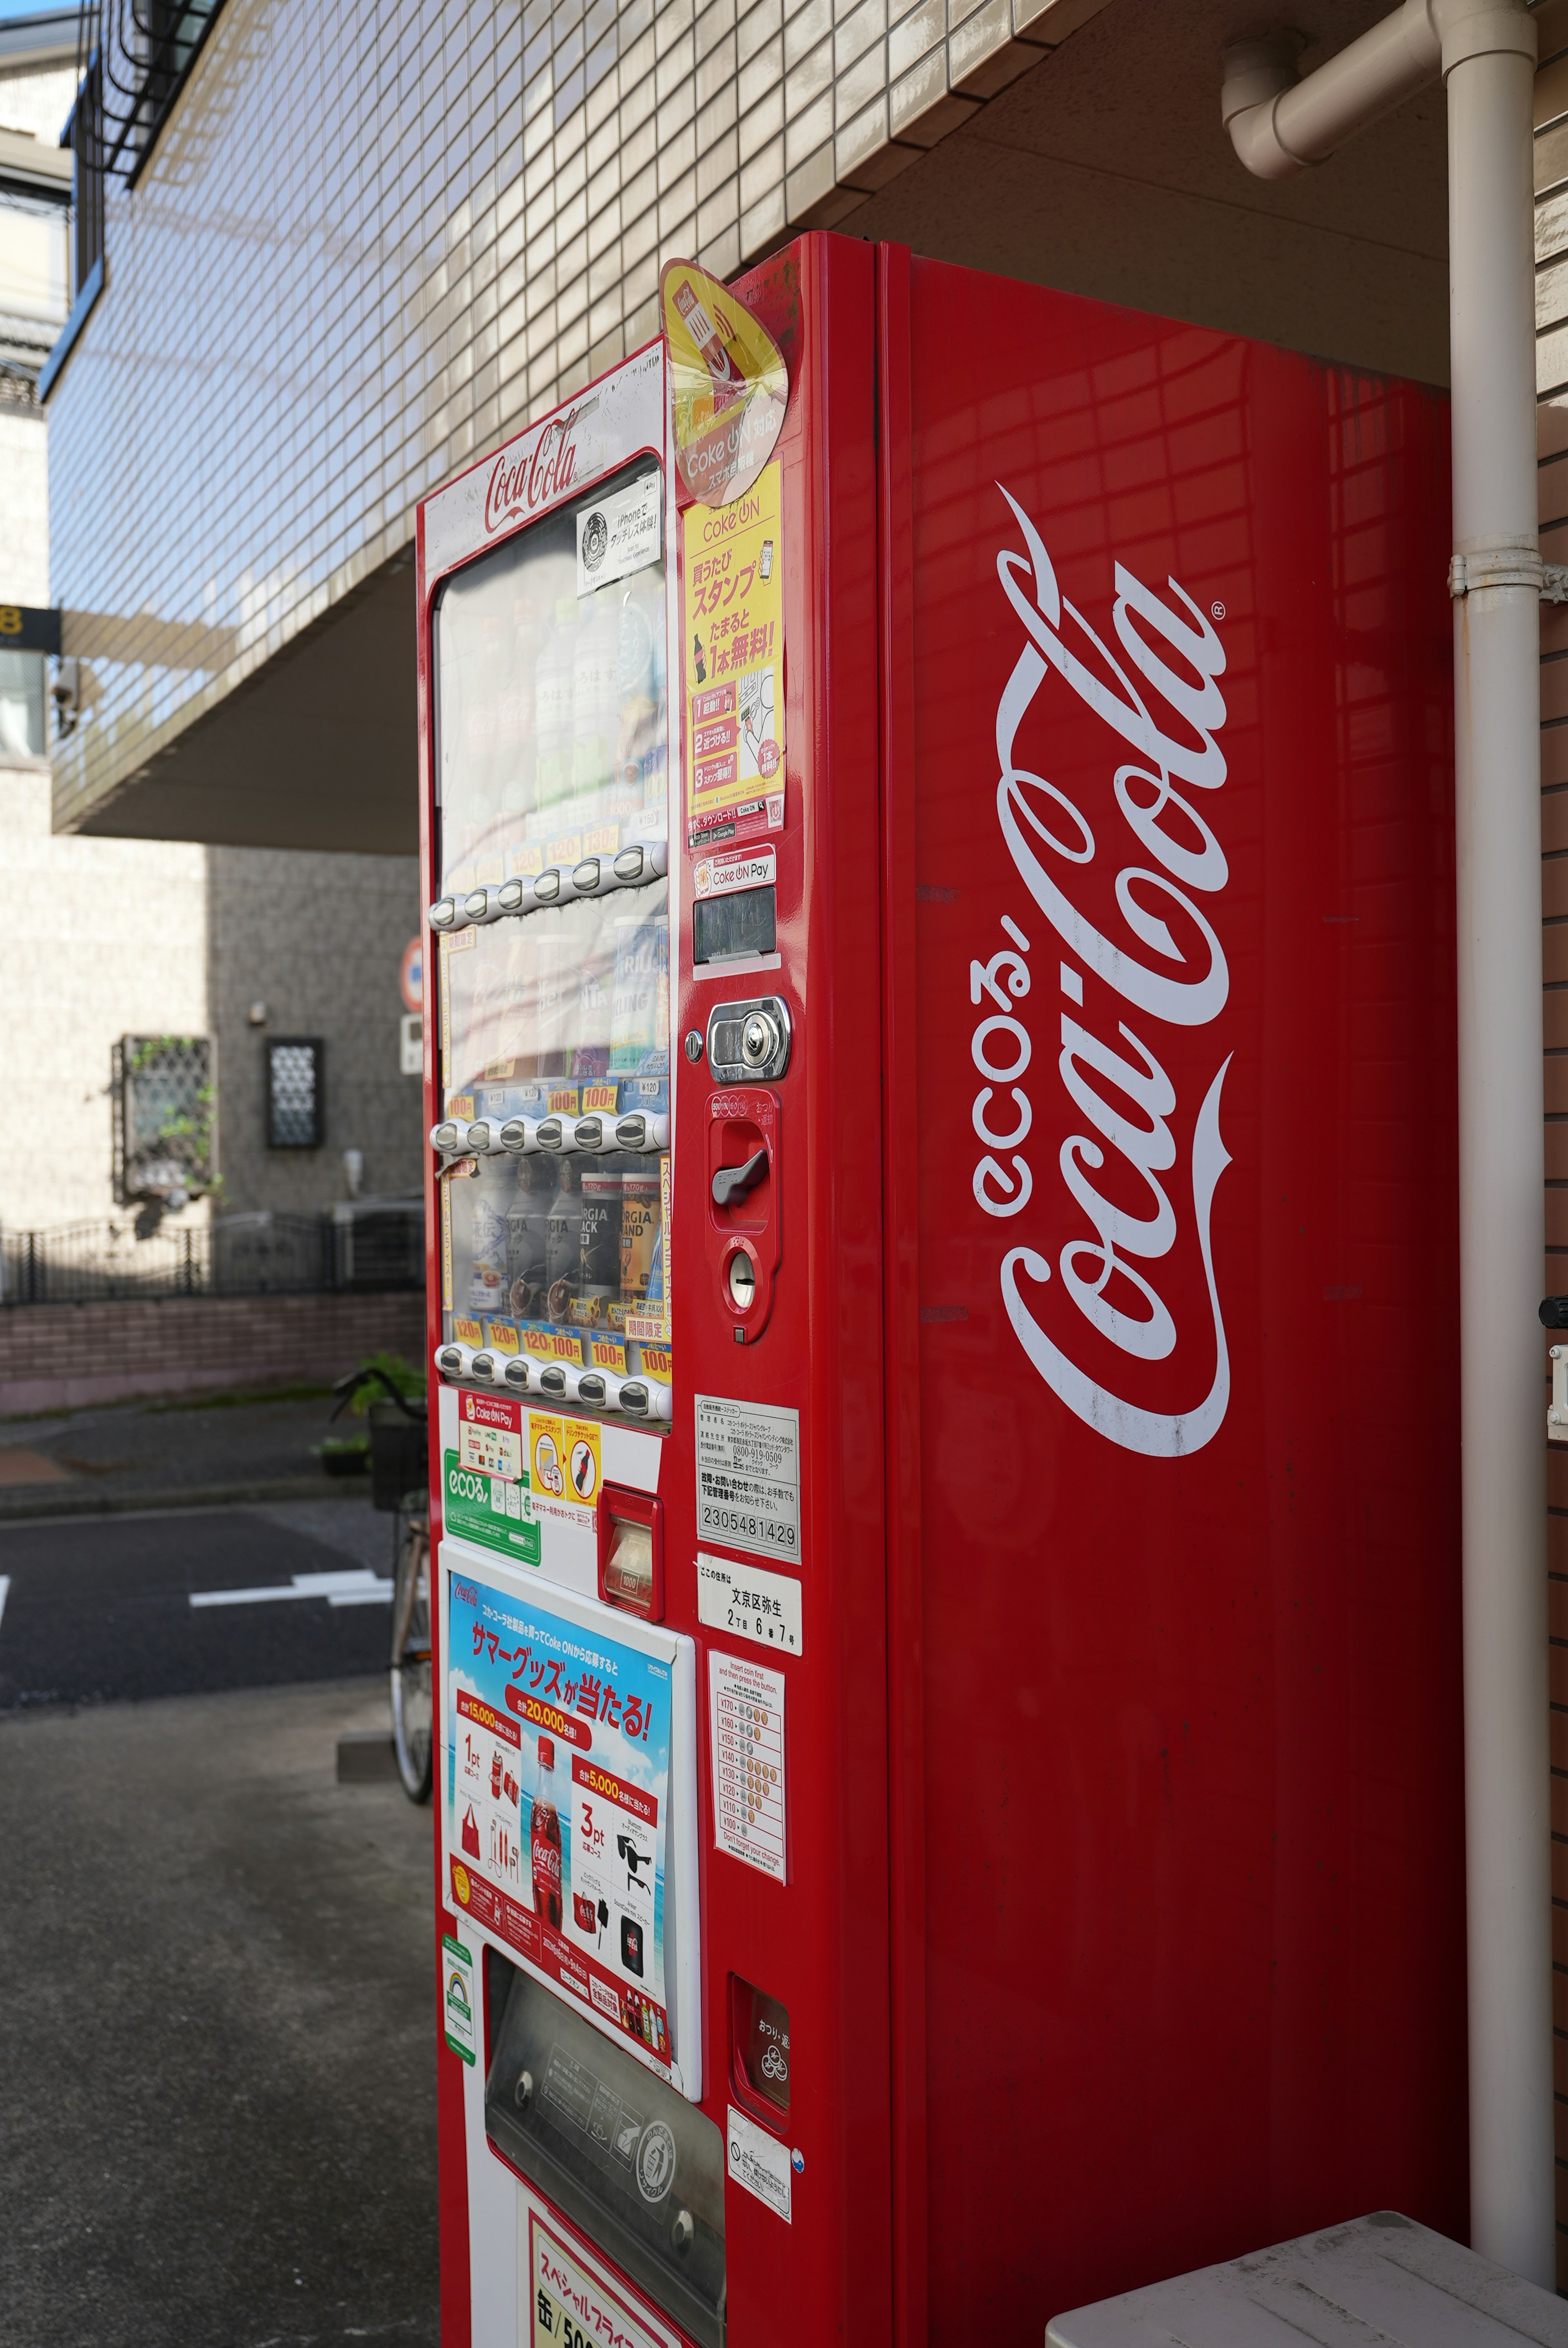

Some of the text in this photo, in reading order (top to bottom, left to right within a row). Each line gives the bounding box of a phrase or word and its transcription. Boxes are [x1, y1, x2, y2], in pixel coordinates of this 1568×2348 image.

[687, 440, 725, 478] Coke
[486, 409, 577, 534] Coca-Cola
[617, 502, 648, 529] iPhoneで
[703, 511, 736, 542] Coke
[739, 496, 760, 524] ON
[611, 514, 657, 548] タッチレス体験!
[693, 548, 733, 588] 買うたび
[693, 560, 757, 621] スタンプ
[710, 608, 750, 643] たまると
[710, 621, 775, 679] 1本無料!
[696, 698, 702, 718] 1
[694, 733, 703, 754] 2
[703, 730, 730, 753] 近づける!!
[695, 768, 703, 789] 3
[587, 828, 617, 853] 130円
[713, 863, 768, 885] Coke ON Pay
[994, 478, 1234, 1459] Coca-Cola
[585, 1088, 615, 1108] 100円
[642, 1083, 657, 1093] ¥120
[448, 1097, 472, 1116] 100円
[549, 1091, 576, 1111] 100円
[756, 1101, 773, 1114] おつり
[581, 1207, 608, 1221] RGIA
[581, 1221, 598, 1233] ACK
[456, 1320, 480, 1338] 120円
[490, 1324, 516, 1345] 120円
[628, 1319, 663, 1338] 期間限定
[552, 1337, 580, 1358] 100円
[593, 1343, 623, 1367] 100円
[476, 1406, 491, 1420] Coke
[501, 1412, 513, 1429] Pay
[566, 1428, 599, 1442] ドリンクチケットGET!
[733, 1445, 782, 1464] 0800-919-0509
[745, 1465, 771, 1476] までとなります。
[701, 1471, 795, 1502] 故障・お問い合わせの際は、お手数でも
[702, 1484, 778, 1511] 下記管理番号をお知らせ下さい。
[532, 1501, 575, 1521] 電子マネー利用がおトクに
[704, 1507, 795, 1545] 2305481429
[623, 1575, 637, 1589] 1000
[700, 1567, 731, 1584] ここの住所は
[732, 1588, 782, 1618] 文京区弥生
[472, 1620, 653, 1742] サマーグッズが当たる!
[719, 1667, 777, 1694] and then press the button.
[730, 1661, 764, 1680] Insert coin first
[721, 1698, 734, 1712] ¥170
[517, 1698, 577, 1740] 合計20,000名様!
[721, 1716, 734, 1730] ¥160
[721, 1733, 734, 1747] ¥150
[722, 1750, 735, 1764] ¥140
[722, 1767, 735, 1780] ¥130
[579, 1769, 651, 1817] 合計5,000名様に当たる!
[723, 1784, 735, 1798] ¥120
[723, 1800, 736, 1814] ¥110
[580, 1802, 605, 1847] 3pt
[724, 1817, 736, 1831] ¥100
[533, 1839, 560, 1878] Coca-Cola
[724, 1831, 735, 1844] Don't
[735, 1835, 749, 1850] forget
[749, 1841, 761, 1853] your
[761, 1845, 780, 1867] change.
[759, 2019, 790, 2050] おつり・返
[646, 2125, 673, 2161] のんだあとは
[639, 2169, 663, 2197] リサイクル
